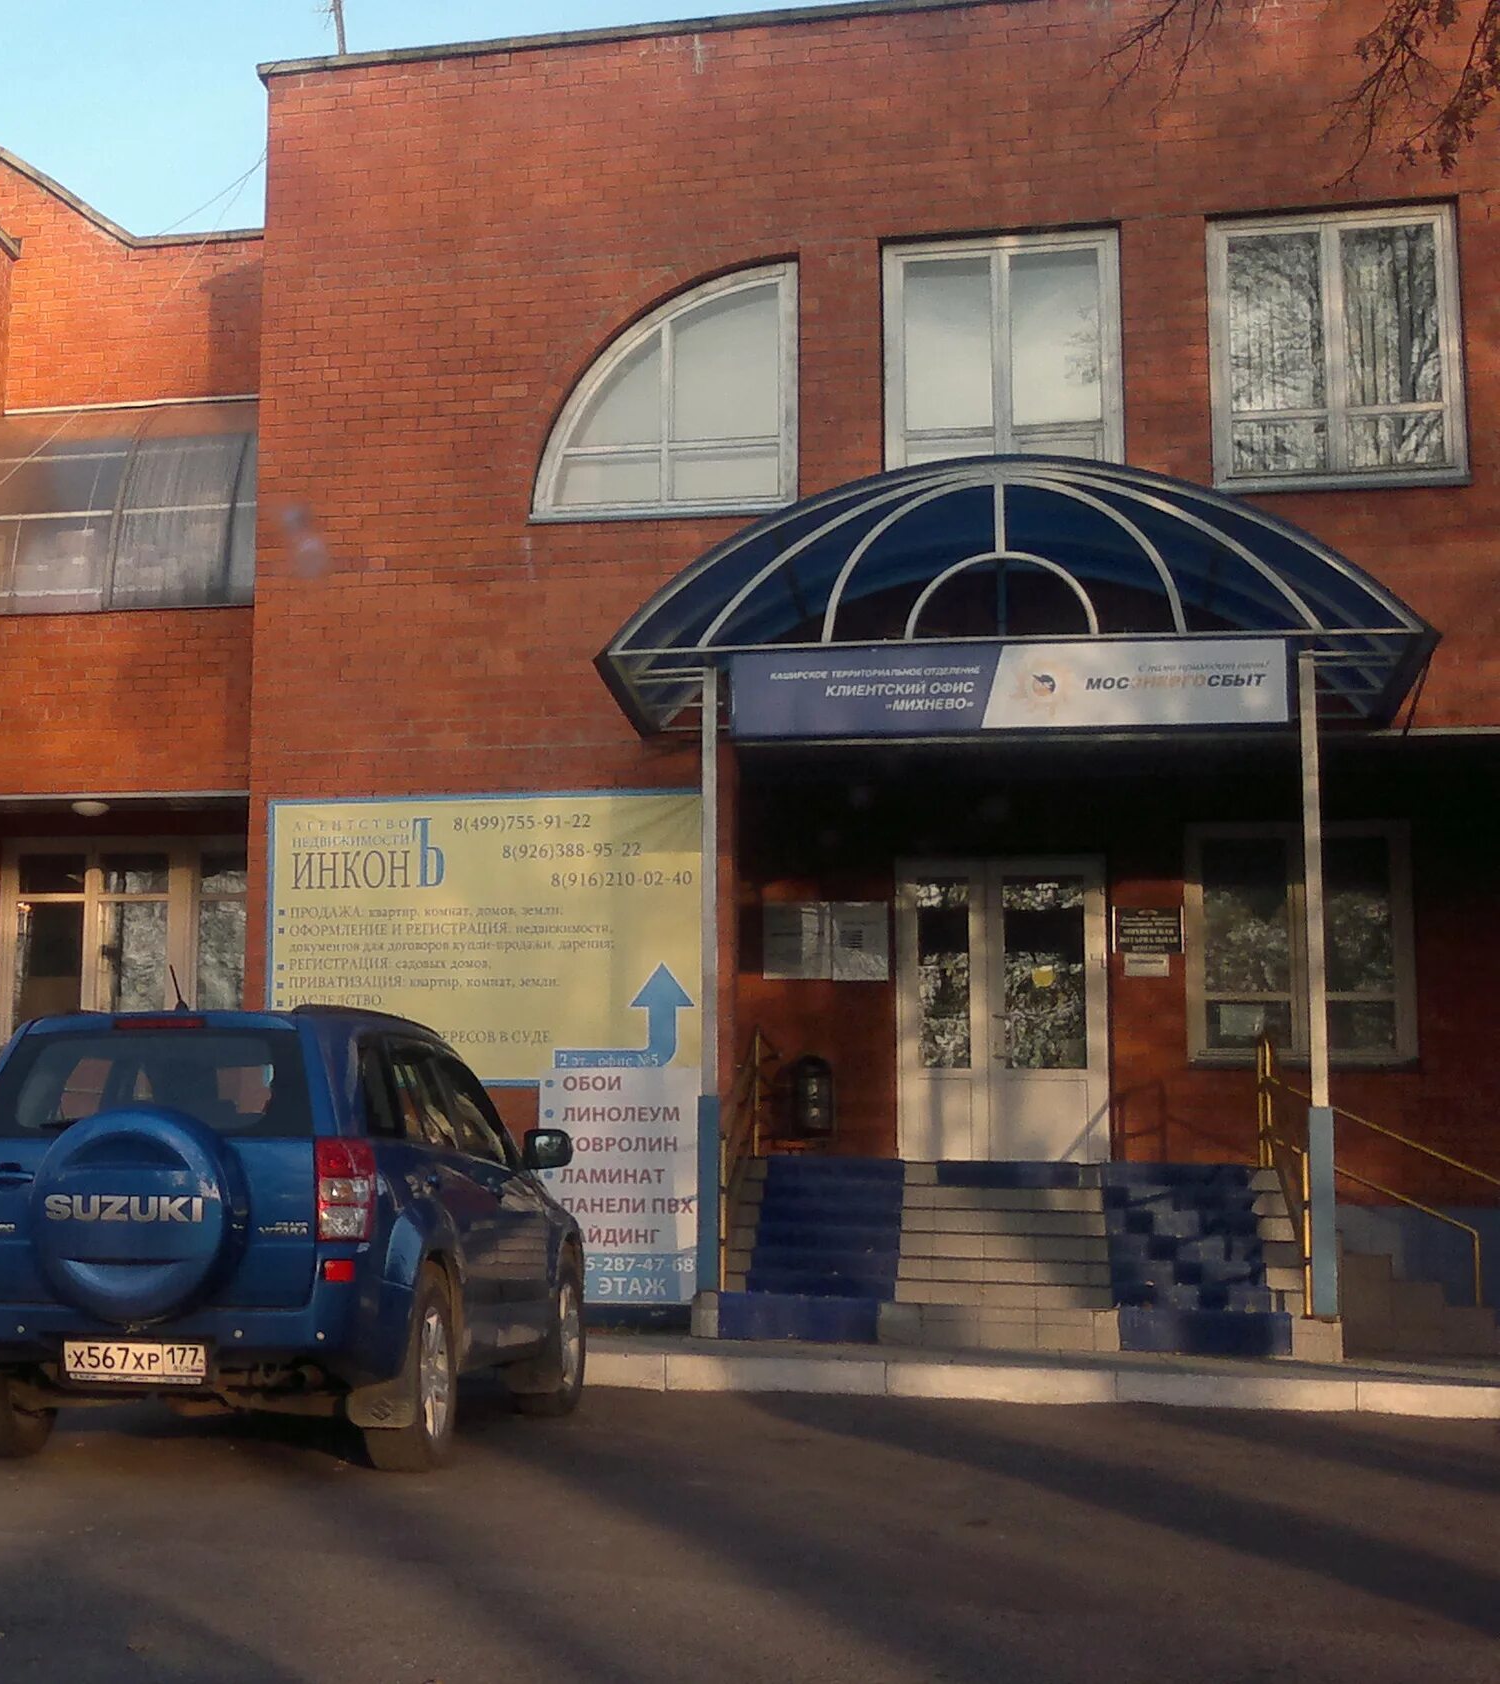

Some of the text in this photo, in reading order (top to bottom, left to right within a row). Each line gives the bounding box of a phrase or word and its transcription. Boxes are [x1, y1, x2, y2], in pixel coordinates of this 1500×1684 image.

[831, 667, 922, 679] ТЕРРИТОРИАЛЬНОЕ
[923, 665, 981, 676] ОТДЕЛЕНИЕ
[825, 681, 975, 697] КЛИЕНТСКИЙ ОФИС
[1085, 673, 1266, 691] МОСЭНЕРГОСБЫТ
[292, 818, 410, 832] АГЕНТСТВО
[453, 814, 591, 833] 8(499)755-91-22
[292, 834, 410, 849] НЕДВИЖИМОСТИ
[502, 841, 642, 862] 8(926)388-95-22
[550, 870, 693, 889] 8(916)210-02-40
[289, 924, 387, 937] ОФОРМЛЕНИЕ
[392, 924, 400, 936] И
[395, 960, 446, 971] садовых
[438, 1030, 496, 1044] ЕРЕСОВ
[499, 1031, 508, 1043] В
[560, 1054, 567, 1066] 2
[598, 1055, 633, 1067] офис
[562, 1075, 622, 1092] ОБОИ
[561, 1106, 680, 1122] ЛИНОЛЕУМ
[560, 1168, 665, 1184] ЛАМИНАТ
[44, 1194, 204, 1222] SUZUKI
[560, 1197, 693, 1214] ПАНЕЛИ ПВХ
[581, 1224, 660, 1248] ЙДИНГ
[598, 1277, 667, 1296] ЭТАЖ
[166, 1346, 199, 1366] 177
